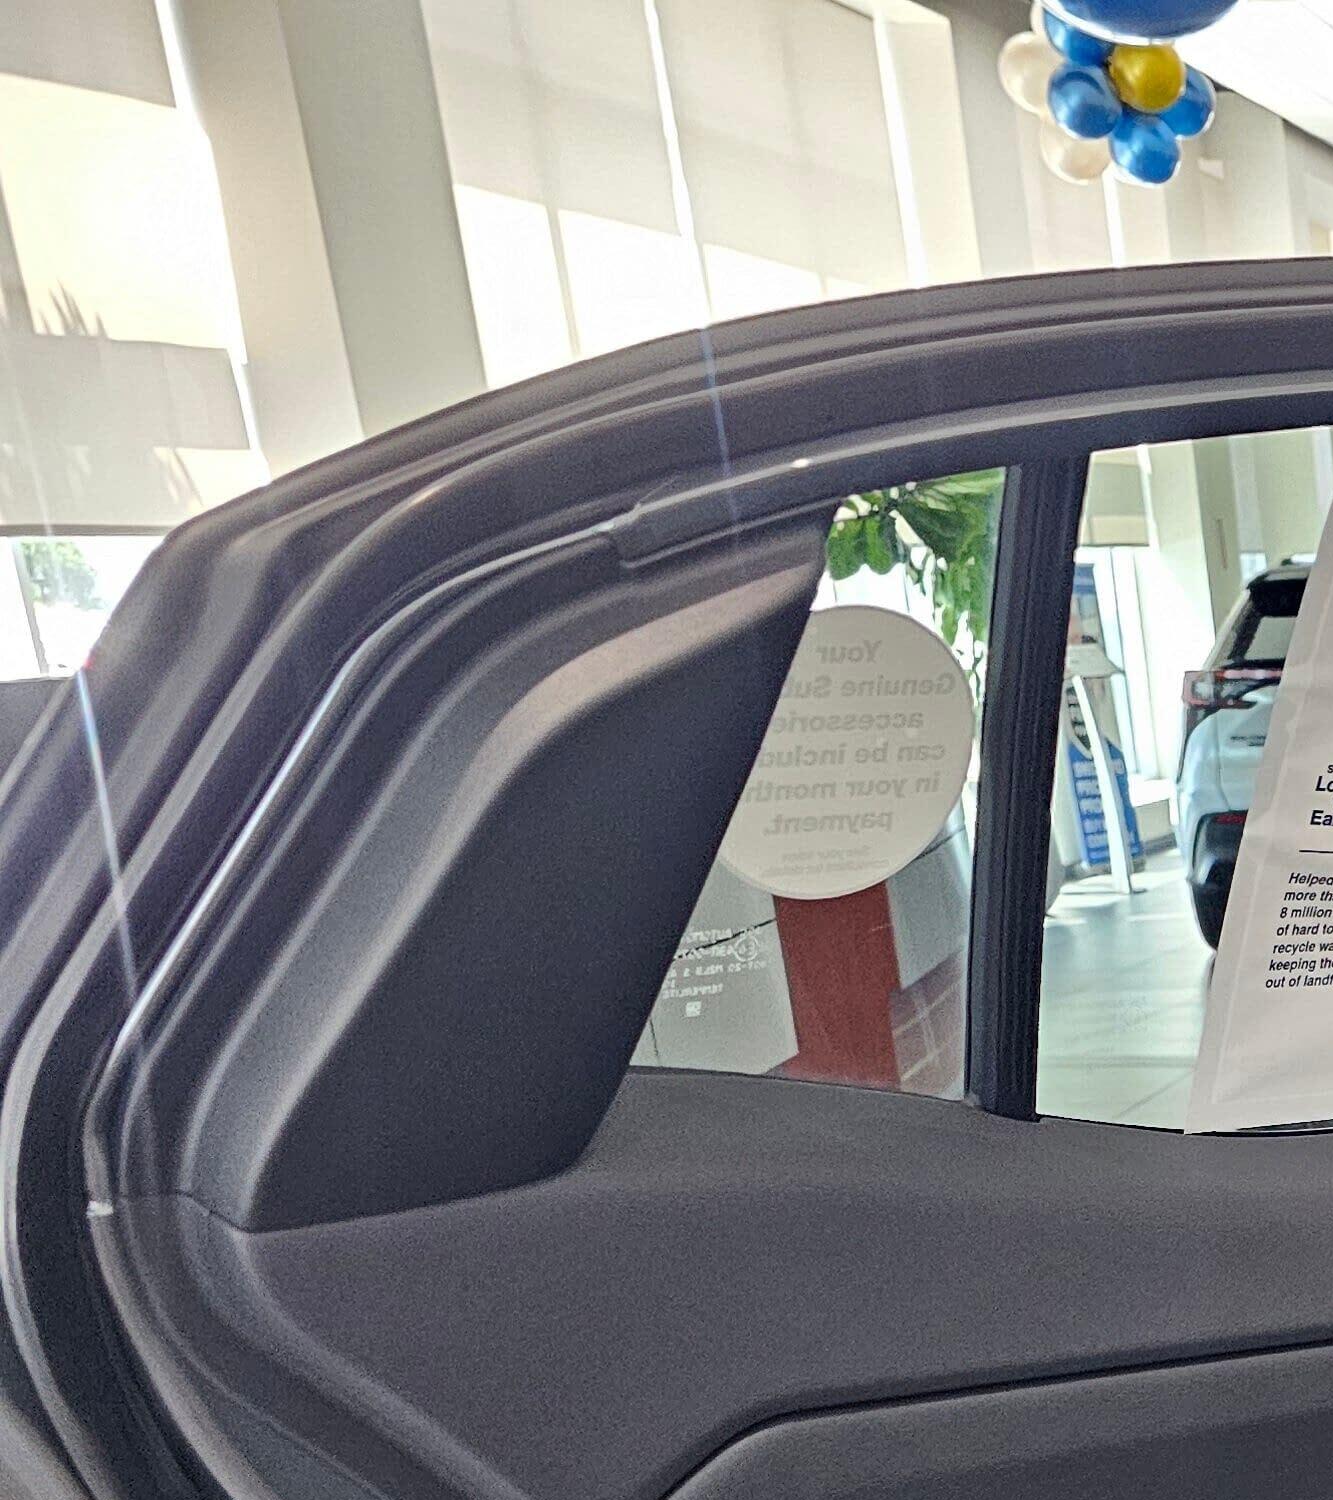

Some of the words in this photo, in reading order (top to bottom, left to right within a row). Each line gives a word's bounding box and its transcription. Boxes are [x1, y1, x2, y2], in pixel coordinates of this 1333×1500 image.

[1283, 891, 1317, 901] more
[1279, 907, 1288, 919] 8
[1290, 906, 1332, 918] million
[1276, 924, 1289, 936] of
[1291, 923, 1320, 936] hard
[1272, 941, 1316, 955] recycle
[1268, 958, 1317, 972] keeping
[1265, 976, 1286, 988] out
[1288, 975, 1301, 987] of
